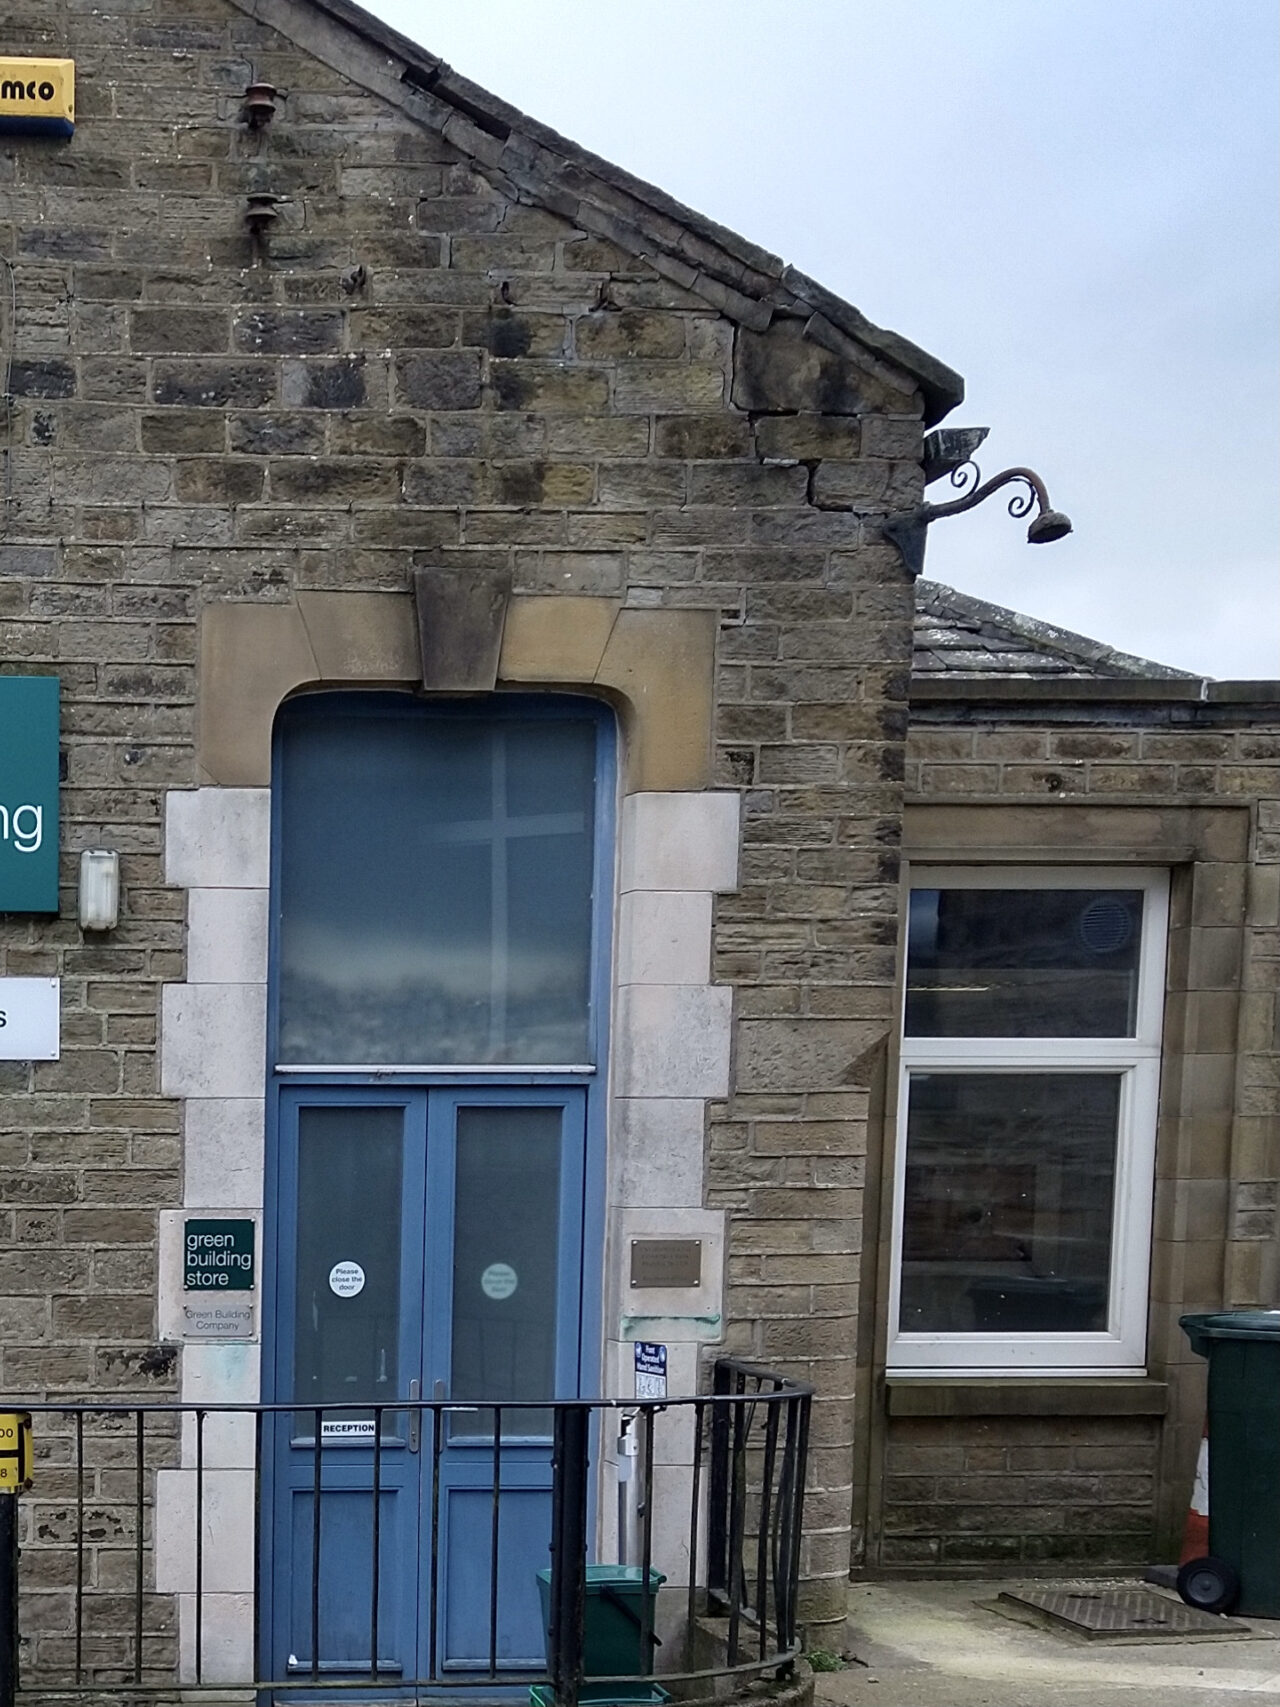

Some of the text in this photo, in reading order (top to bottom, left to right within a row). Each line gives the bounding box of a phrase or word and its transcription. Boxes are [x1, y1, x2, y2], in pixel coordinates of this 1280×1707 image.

[187, 1234, 235, 1250] green
[187, 1251, 252, 1270] building
[186, 1270, 229, 1286] store
[185, 1310, 251, 1321] Green Building
[196, 1321, 239, 1331] Company
[323, 1424, 375, 1433] RECEPTION
[0, 1468, 8, 1478] 8
